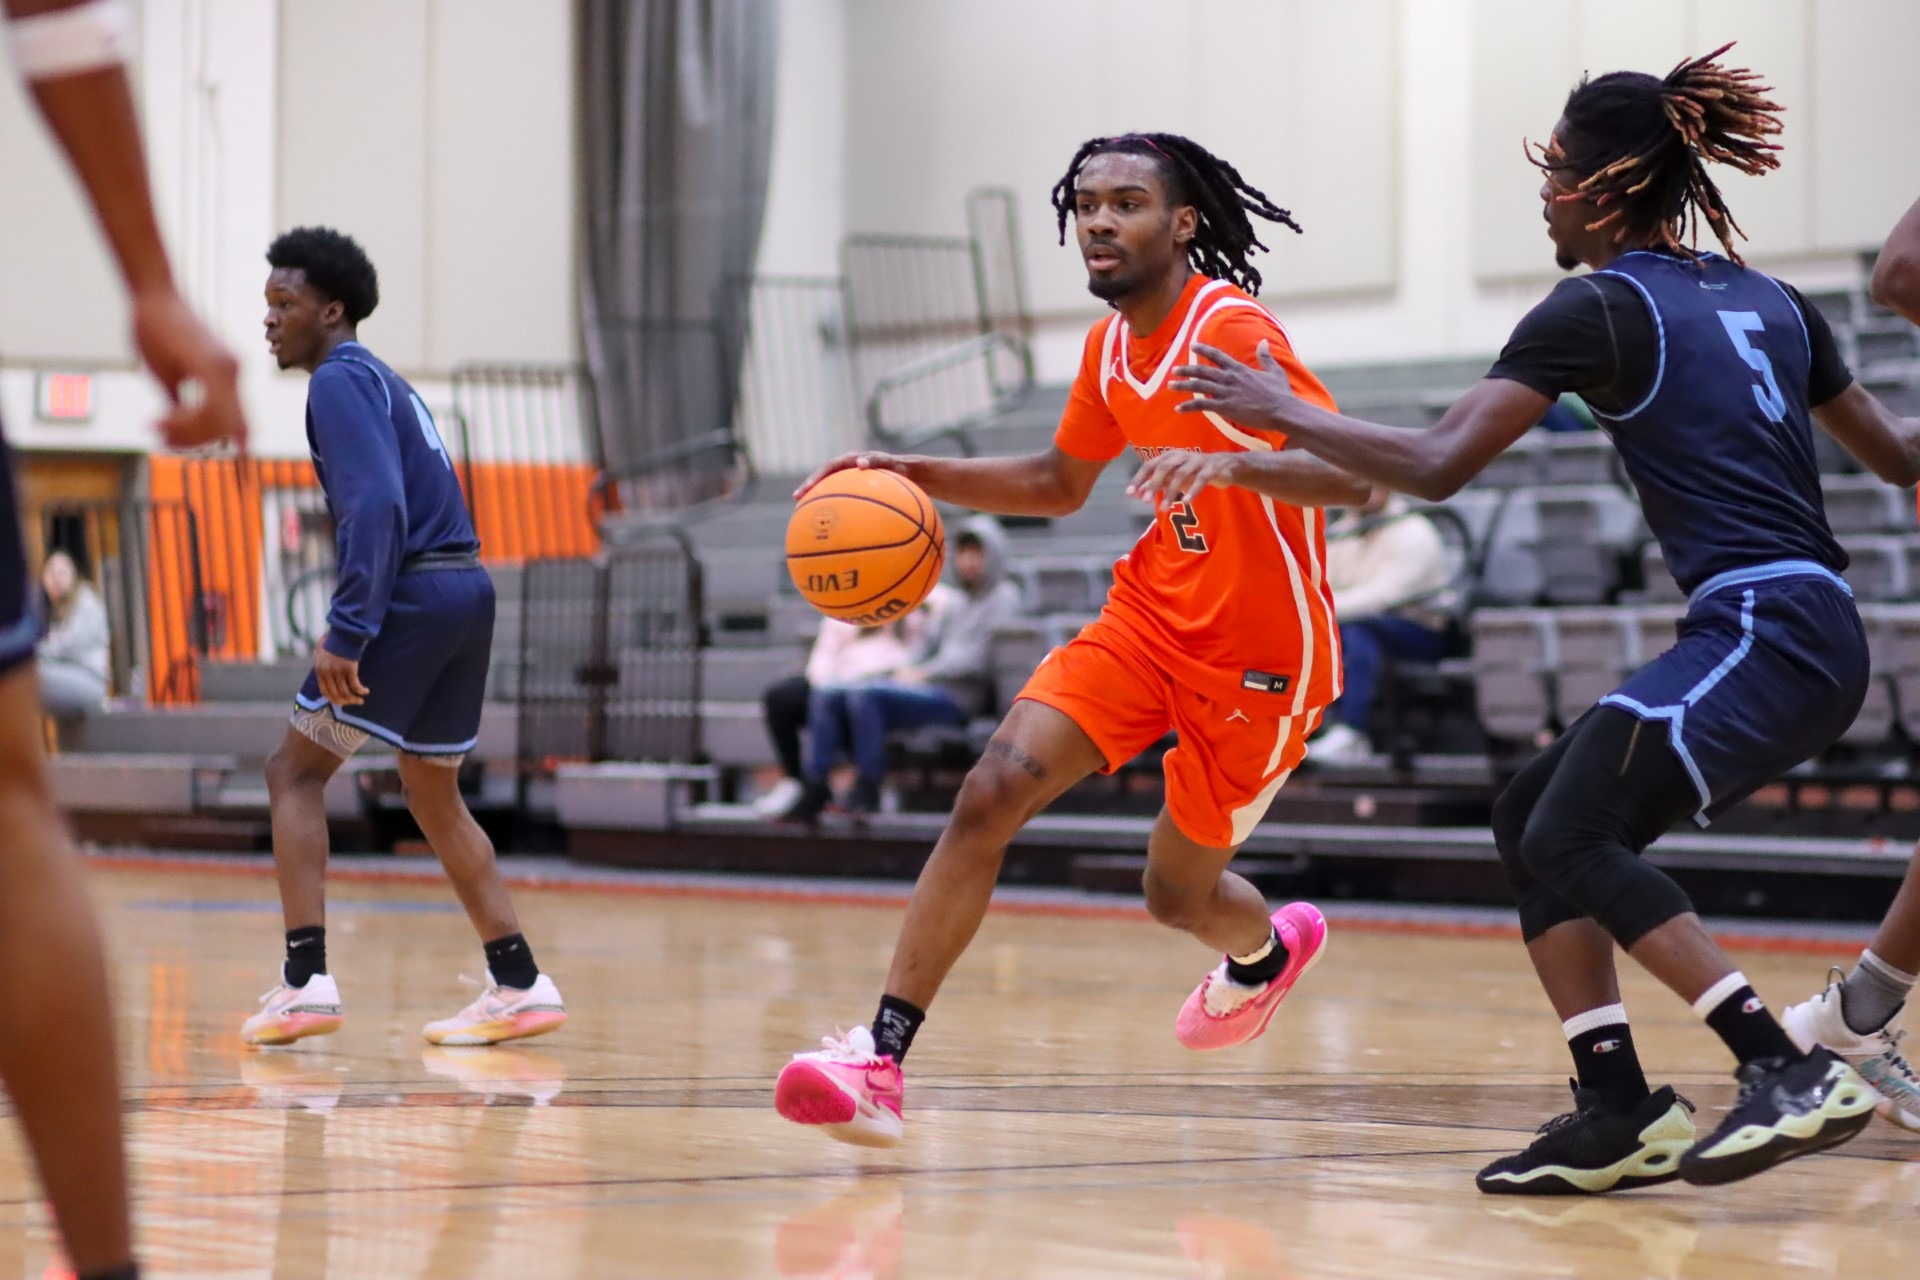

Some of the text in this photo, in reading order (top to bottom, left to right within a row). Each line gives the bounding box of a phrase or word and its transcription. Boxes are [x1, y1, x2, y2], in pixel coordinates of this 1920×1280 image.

[1716, 310, 1787, 423] 5
[408, 393, 450, 471] 4
[1168, 491, 1210, 554] 2
[808, 569, 859, 592] EVO
[1273, 681, 1284, 690] M
